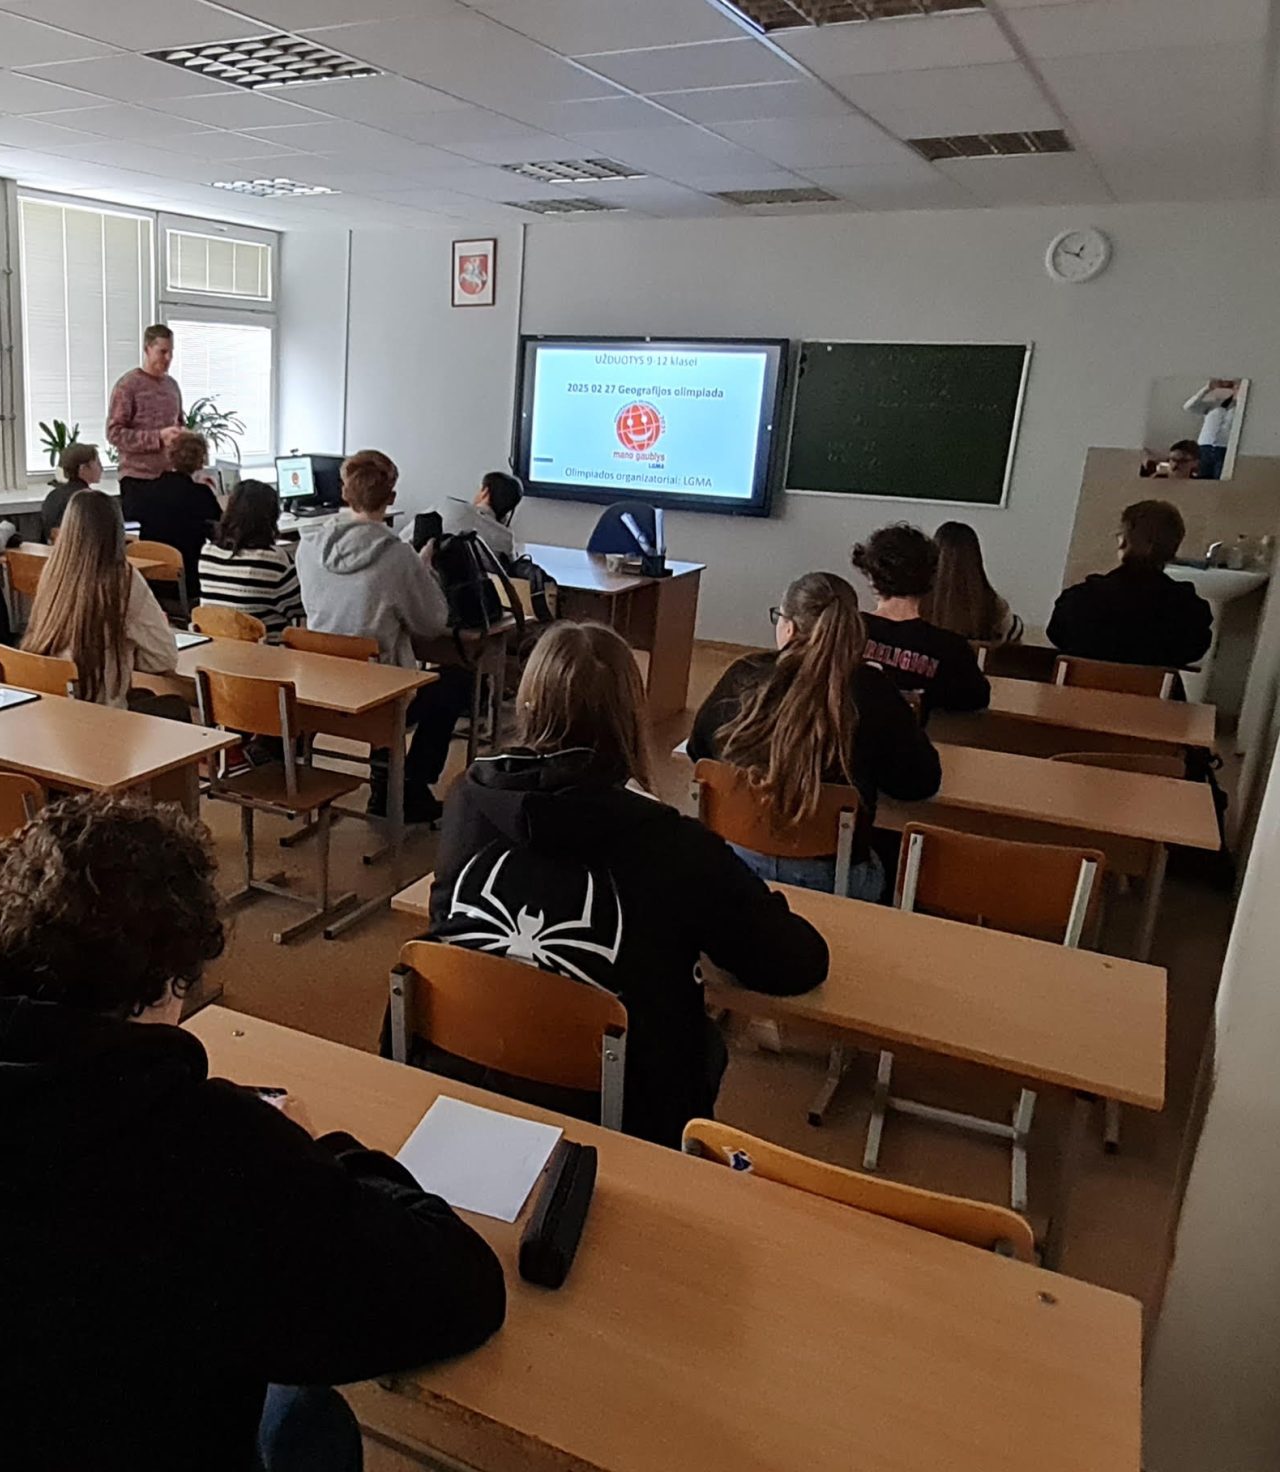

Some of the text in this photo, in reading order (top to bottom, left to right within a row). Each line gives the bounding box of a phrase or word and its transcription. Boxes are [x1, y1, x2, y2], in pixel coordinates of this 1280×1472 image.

[670, 356, 698, 367] klasei
[567, 383, 724, 399] 2025 02 27 Geografijos olimpiada
[613, 451, 665, 462] mano gaublys
[565, 467, 615, 481] Olimpiados
[683, 476, 712, 488] LGMA
[862, 639, 940, 678] RELIGION
